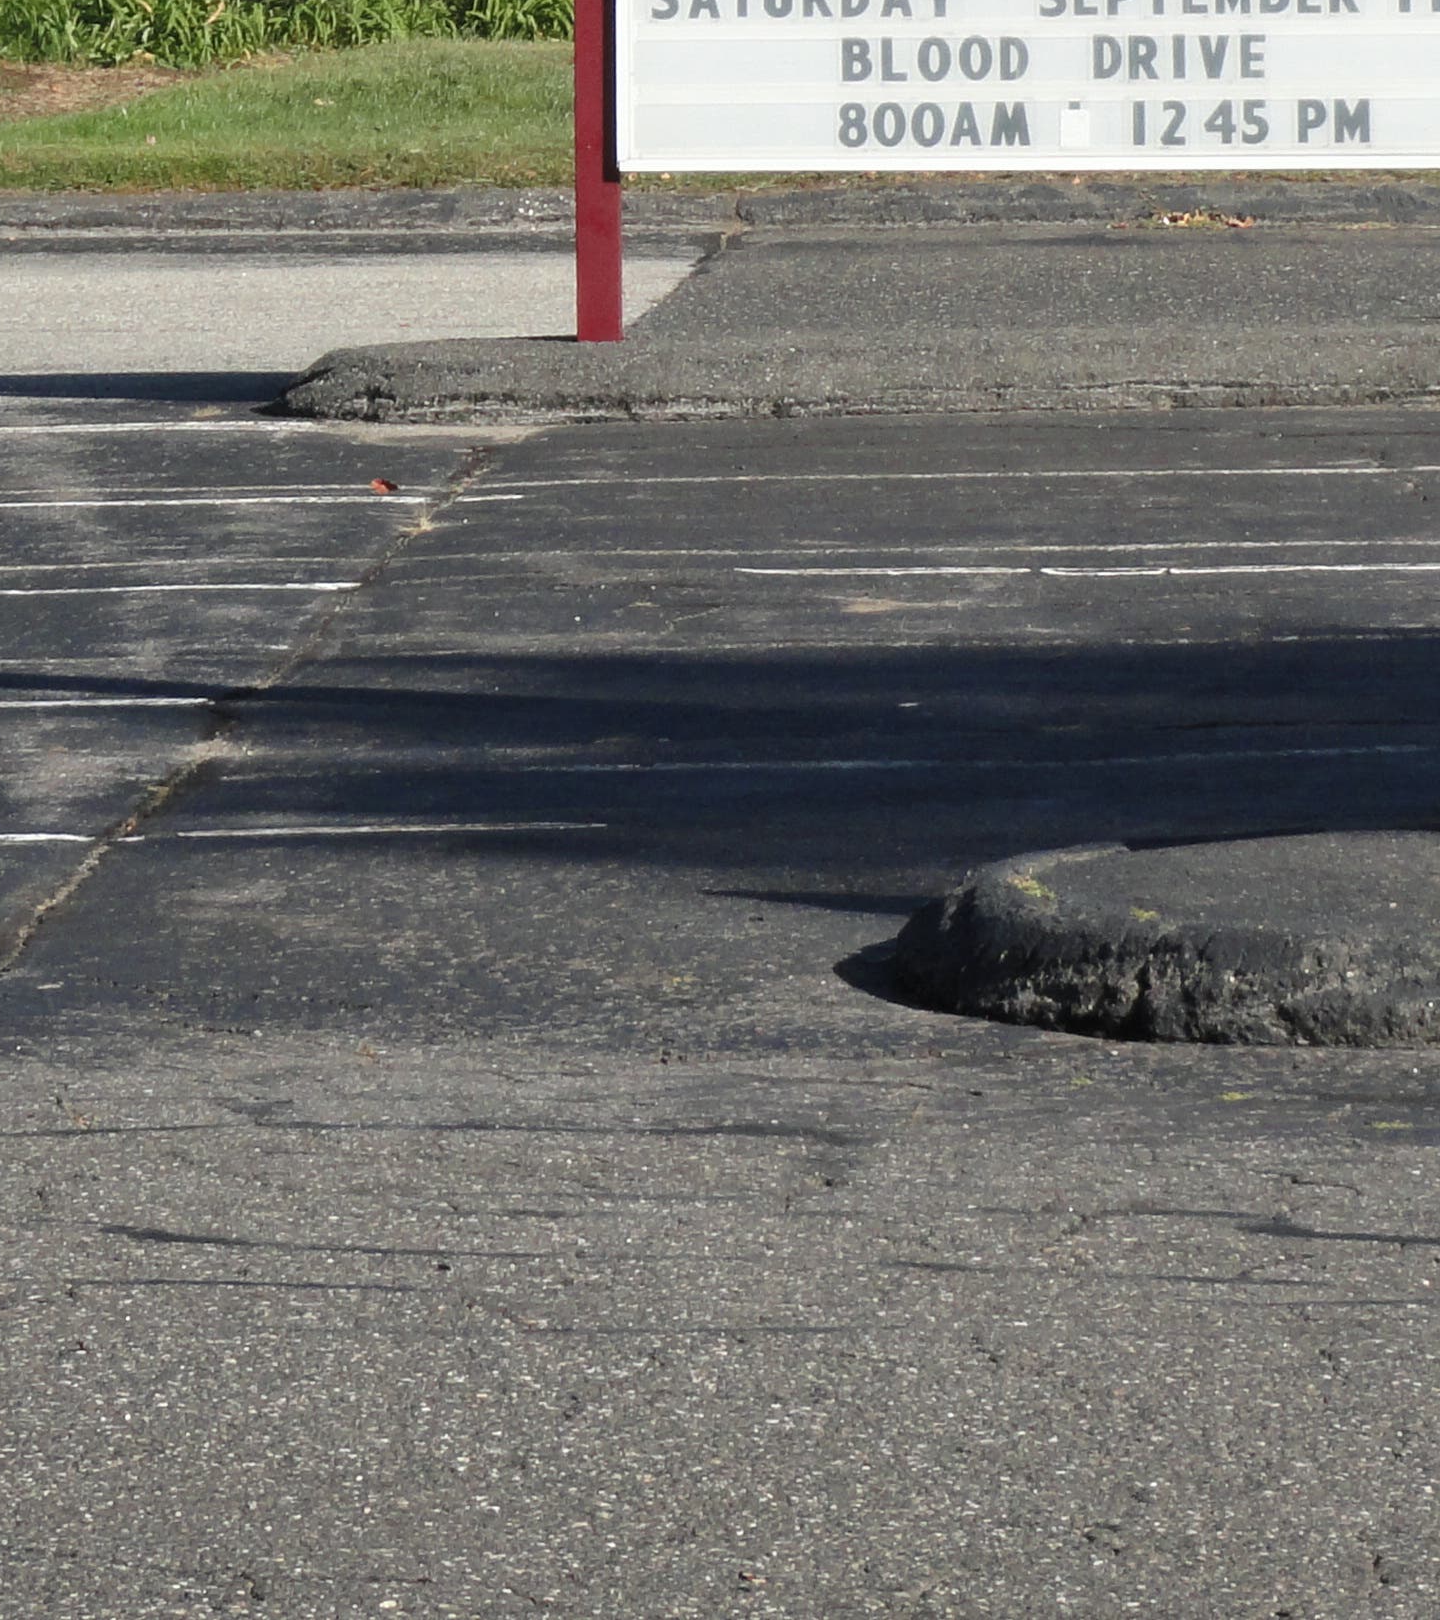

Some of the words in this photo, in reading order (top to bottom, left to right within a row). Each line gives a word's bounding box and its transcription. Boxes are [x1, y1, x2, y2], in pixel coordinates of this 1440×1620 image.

[840, 35, 1030, 82] BLOOD
[1092, 33, 1267, 80] DRIVE
[838, 101, 1031, 148] 800AM
[1296, 98, 1372, 144] PM
